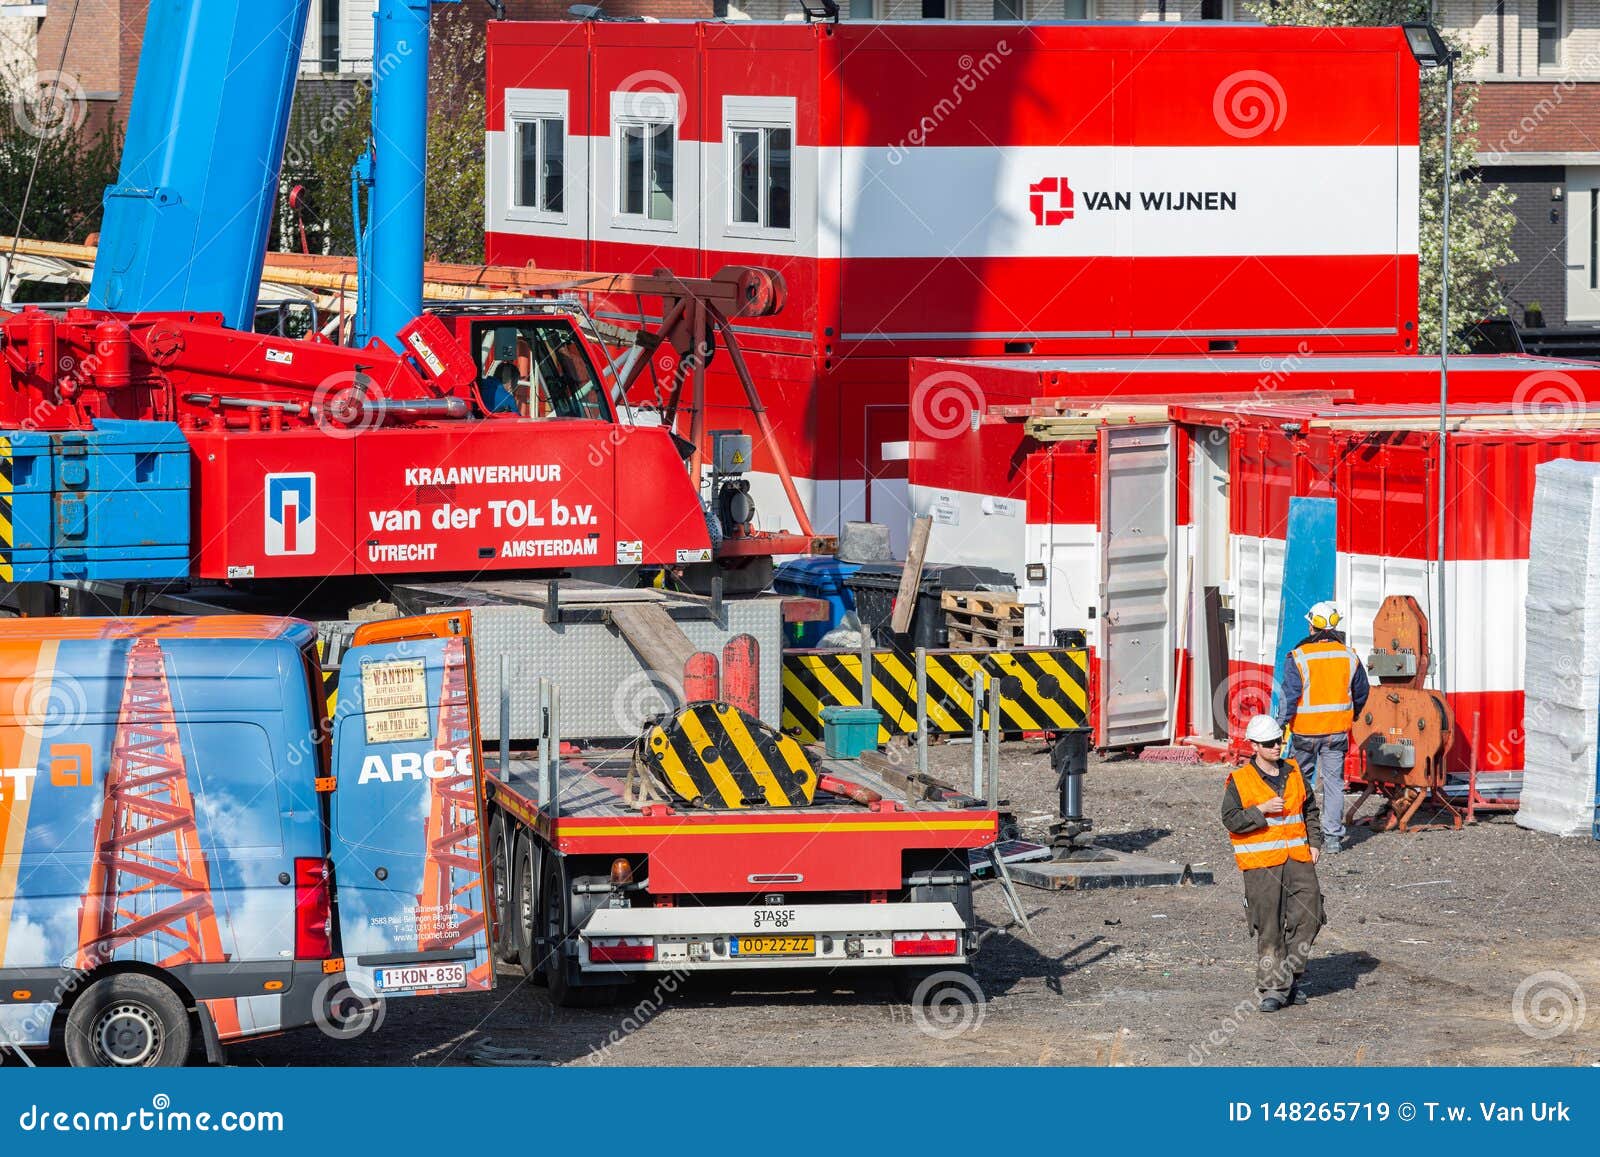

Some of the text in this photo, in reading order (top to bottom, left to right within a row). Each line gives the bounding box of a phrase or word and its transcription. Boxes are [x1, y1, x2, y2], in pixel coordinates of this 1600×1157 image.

[1082, 191, 1237, 211] VAN WIJNEN
[405, 464, 561, 486] KRAANVERHUUR
[369, 499, 597, 531] van der TOL b.v.
[369, 538, 598, 562] UTRECHT AMSTERDAM
[373, 667, 414, 686] WANTED
[405, 717, 419, 730] LIFE
[0, 768, 37, 801] T
[754, 910, 796, 921] STASSE
[743, 938, 809, 952] 00-22-ZZ
[385, 966, 463, 985] 1-KDN-836
